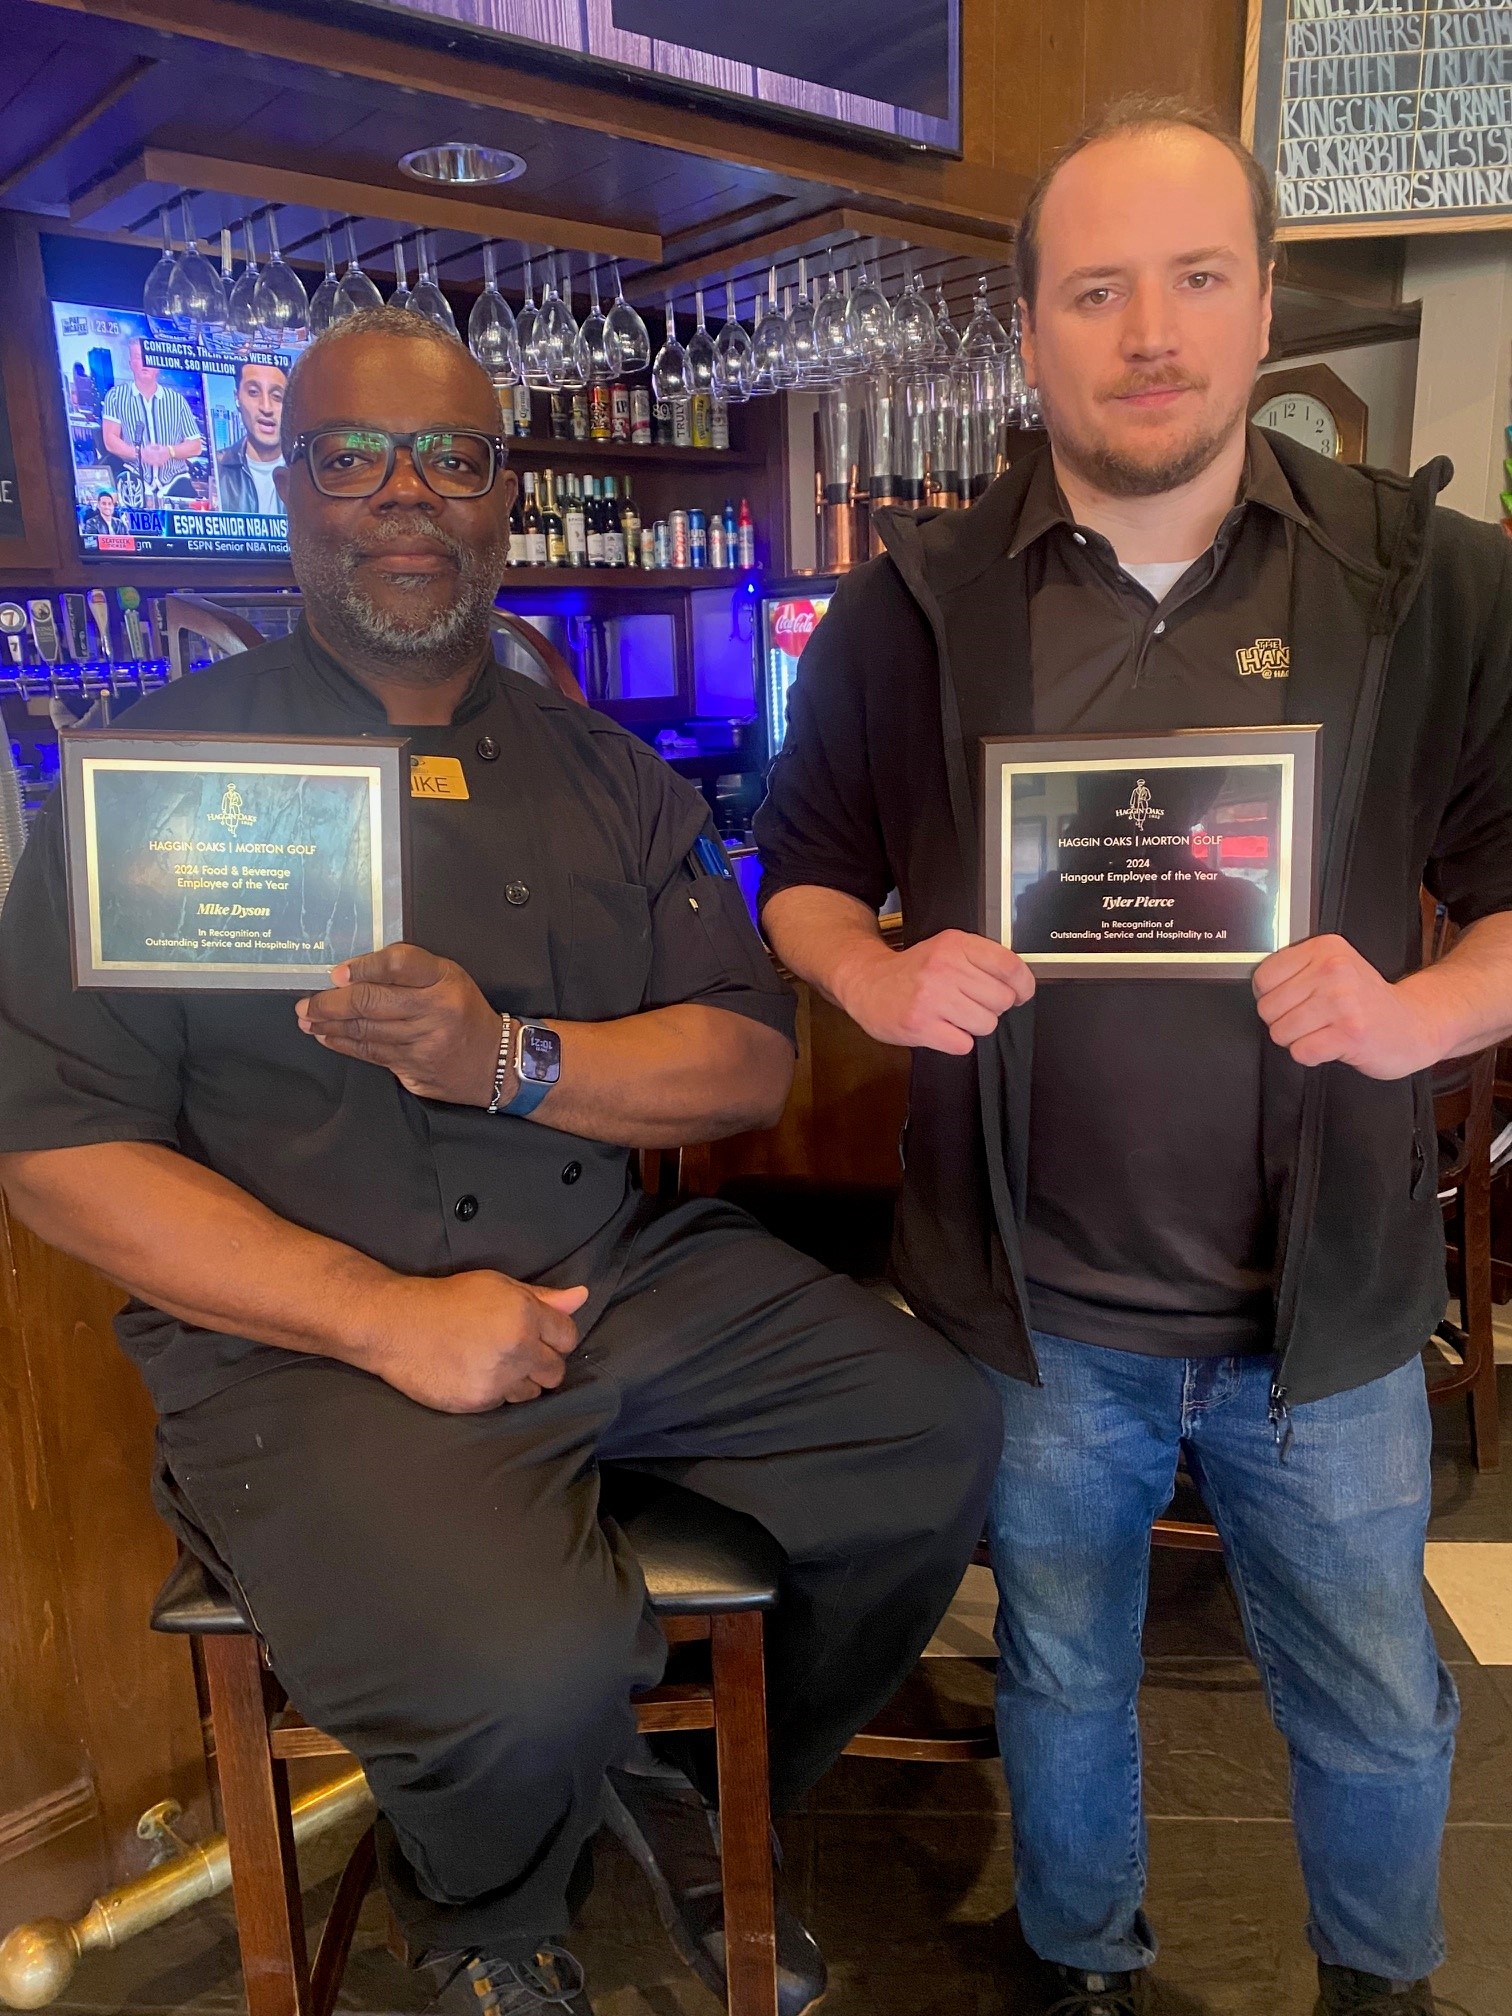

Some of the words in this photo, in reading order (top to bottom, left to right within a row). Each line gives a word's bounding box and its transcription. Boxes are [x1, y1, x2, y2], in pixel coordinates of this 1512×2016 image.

[1283, 98, 1346, 138] KING
[144, 340, 196, 357] CONTRACTS,
[250, 353, 273, 364] WERE
[274, 355, 289, 366] $70
[145, 355, 183, 370] MILLION,
[185, 359, 200, 371] $80
[202, 361, 236, 374] MILLION
[1284, 402, 1296, 418] 12
[676, 402, 685, 438] TRULY
[1269, 411, 1277, 427] 11
[1315, 420, 1324, 433] 2
[1321, 439, 1330, 454] 3
[130, 512, 162, 531] NBA
[173, 515, 204, 536] ESPN
[205, 516, 245, 537] SENIOR
[246, 518, 269, 537] NBA
[188, 540, 213, 551] ESPN
[215, 541, 244, 551] Senior
[246, 542, 267, 552] NBA
[1258, 641, 1279, 649] THE
[410, 776, 450, 793] IKE
[1058, 837, 1100, 847] HAGGIN
[1103, 836, 1132, 847] OAKS
[1142, 836, 1190, 846] MORTON
[1193, 835, 1223, 845] GOLF
[149, 841, 193, 851] HAGGIN
[196, 841, 226, 852] OAKS
[235, 844, 284, 854] MORTON
[287, 845, 316, 855] GOLF
[1126, 858, 1150, 868] 2024
[174, 865, 199, 875] 2024
[202, 865, 227, 875] Food
[231, 866, 239, 876] &
[242, 866, 291, 878] Beverage
[1060, 873, 1104, 883] Hangout
[1107, 872, 1157, 883] Employee
[1160, 871, 1172, 881] of
[1175, 871, 1191, 881] the
[1194, 871, 1218, 880] Year
[177, 878, 229, 890] Employee
[232, 878, 243, 889] of
[245, 879, 262, 889] the
[265, 880, 289, 890] Year
[1102, 896, 1133, 910] Tyler
[1134, 896, 1175, 908] Pierce
[197, 903, 231, 916] Mike
[230, 904, 271, 918] Dyson
[1112, 920, 1162, 929] Recognition
[1164, 920, 1174, 928] of
[198, 928, 206, 936] In
[209, 928, 260, 938] Recognition
[262, 929, 272, 938] of
[1050, 931, 1101, 940] Outstanding
[1104, 931, 1134, 939] Service
[1137, 931, 1153, 939] and
[1156, 931, 1202, 940] Hospitality
[1215, 930, 1227, 939] All
[145, 938, 198, 948] Outstanding
[201, 939, 232, 948] Service
[235, 939, 252, 948] and
[254, 941, 300, 951] Hospitality
[302, 942, 310, 950] to
[313, 941, 325, 950] All
